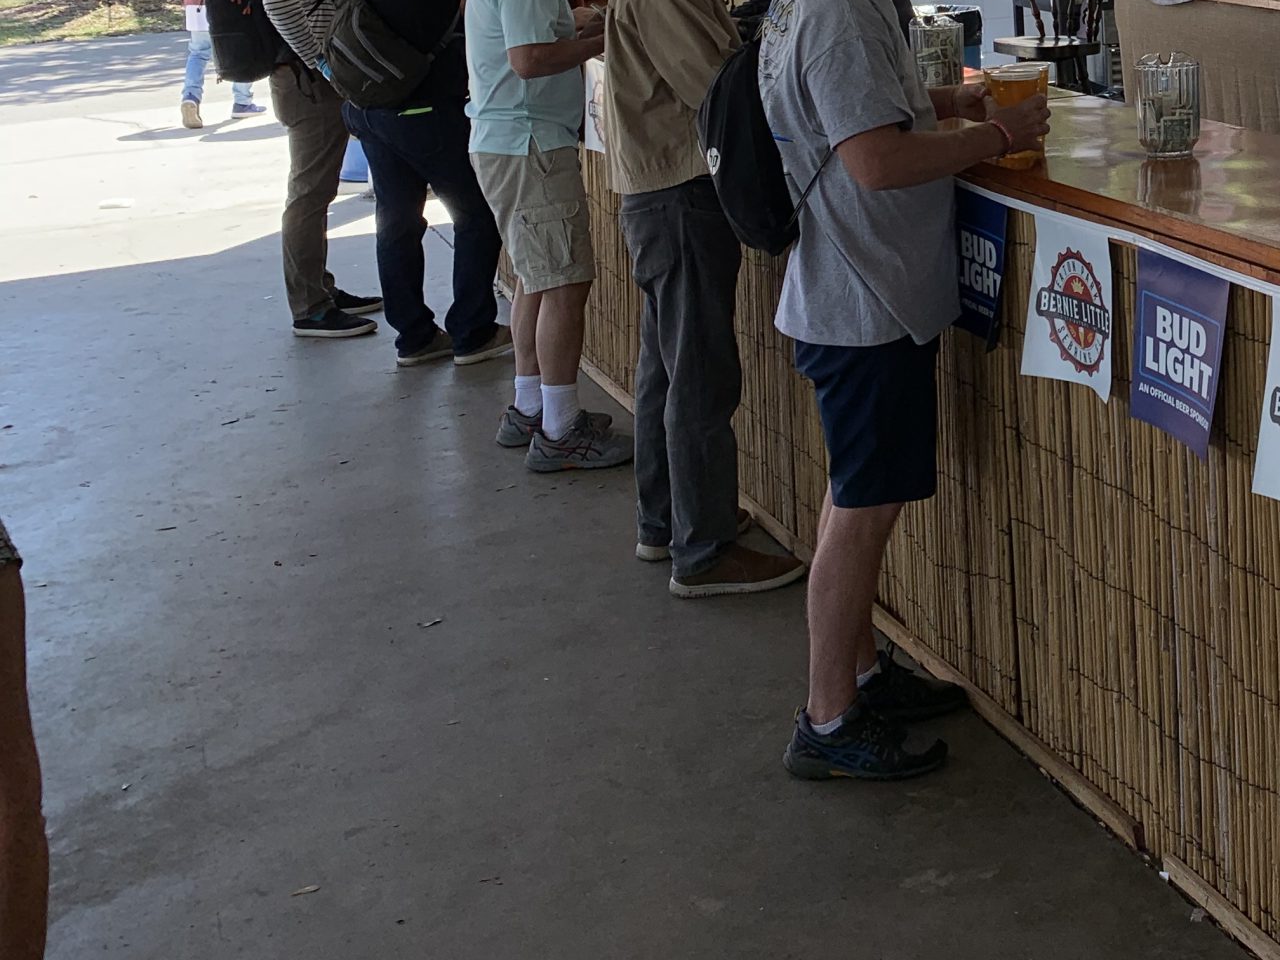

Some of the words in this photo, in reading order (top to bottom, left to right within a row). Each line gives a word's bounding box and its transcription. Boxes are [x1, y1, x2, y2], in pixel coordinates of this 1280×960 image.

[961, 229, 997, 269] BUD
[960, 259, 1002, 298] IGHT
[1055, 260, 1077, 288] EATON
[1080, 265, 1100, 301] PARK
[1040, 290, 1080, 320] BERNIE
[1081, 301, 1110, 333] LITTLE
[1156, 305, 1207, 357] BUD
[1145, 336, 1213, 400] LIGHT
[1138, 382, 1149, 394] AN
[1149, 386, 1176, 408] OFFICIAL
[1175, 399, 1190, 415] BEER
